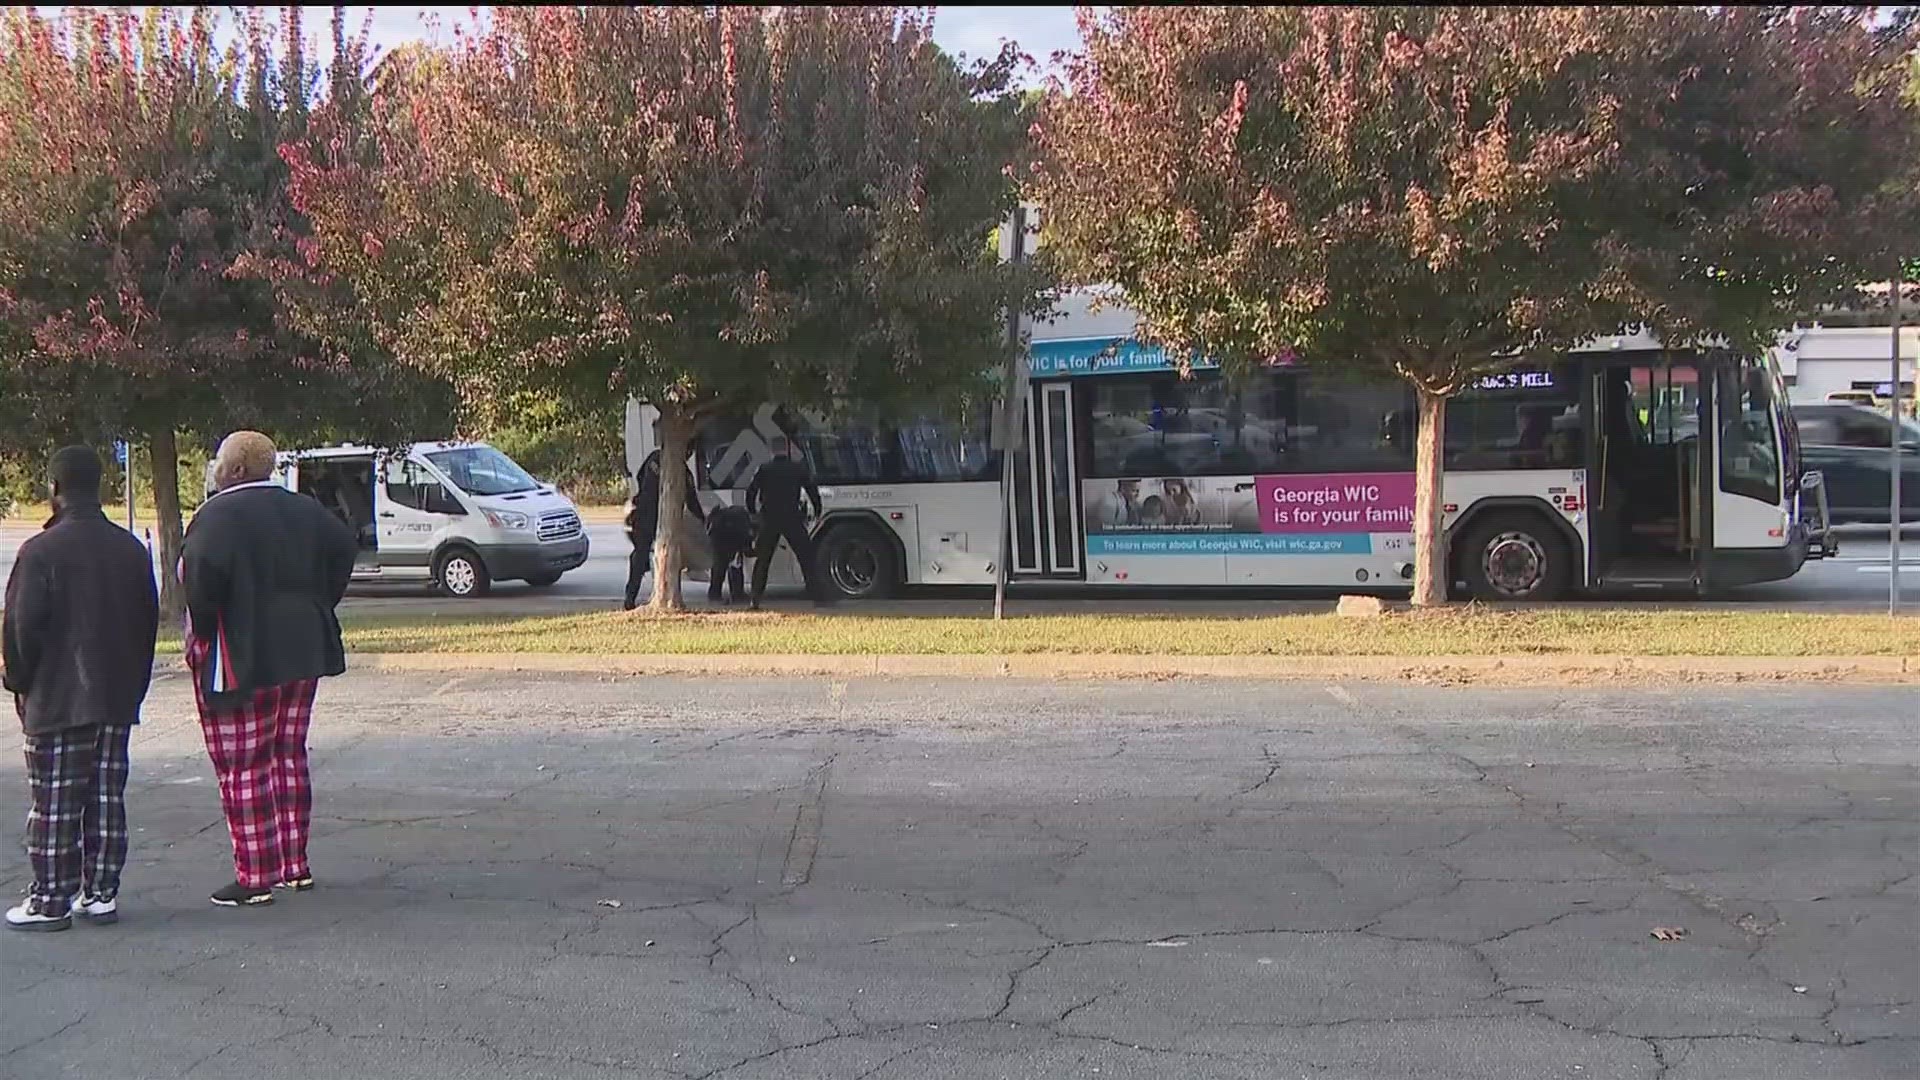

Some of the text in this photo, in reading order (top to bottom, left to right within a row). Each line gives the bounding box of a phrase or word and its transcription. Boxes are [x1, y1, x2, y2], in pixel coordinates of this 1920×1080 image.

[1070, 354, 1090, 369] for
[1129, 350, 1172, 366] famil
[1273, 485, 1379, 506] Georgia WIC
[1274, 508, 1288, 522] is
[1293, 507, 1318, 522] for
[1322, 509, 1360, 526] your
[1142, 542, 1167, 550] more
[1169, 540, 1197, 550] about
[1200, 539, 1238, 551] Georgia
[1266, 539, 1286, 549] visit
